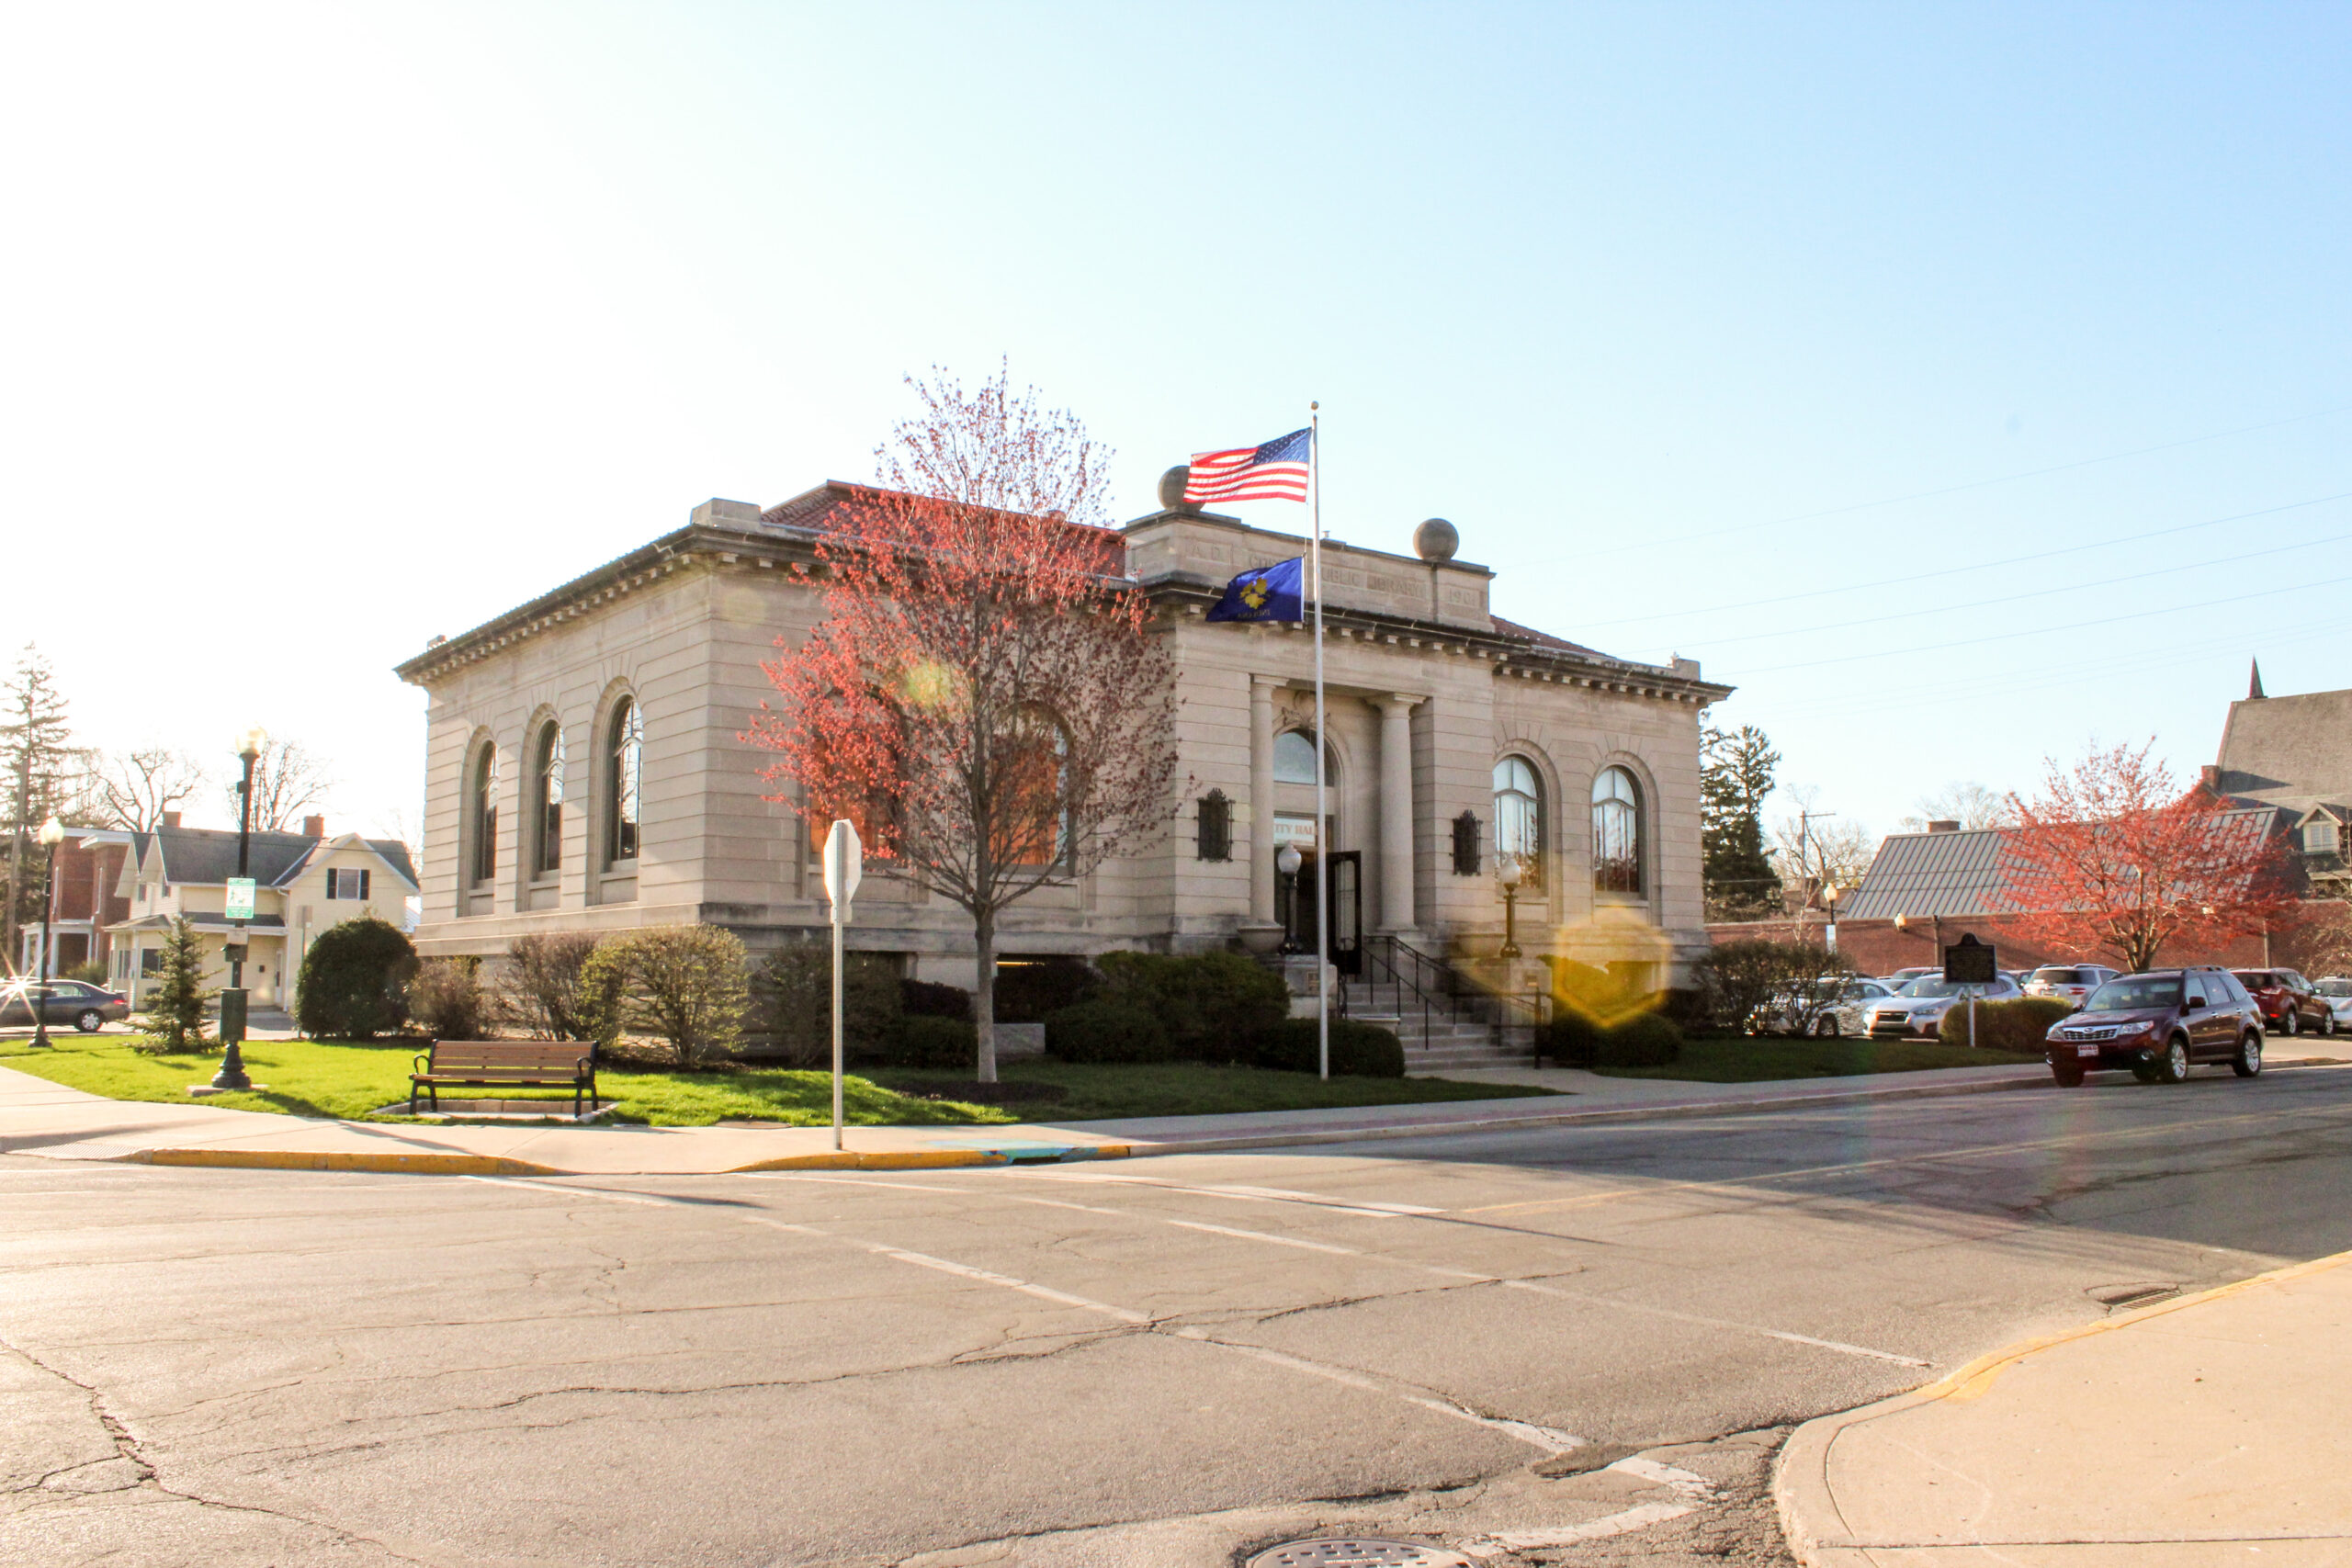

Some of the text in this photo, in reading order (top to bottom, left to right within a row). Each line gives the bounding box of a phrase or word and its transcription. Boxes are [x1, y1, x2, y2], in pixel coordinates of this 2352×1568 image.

[1320, 566, 1361, 587] UBLIC
[1274, 823, 1315, 835] ITY HAL
